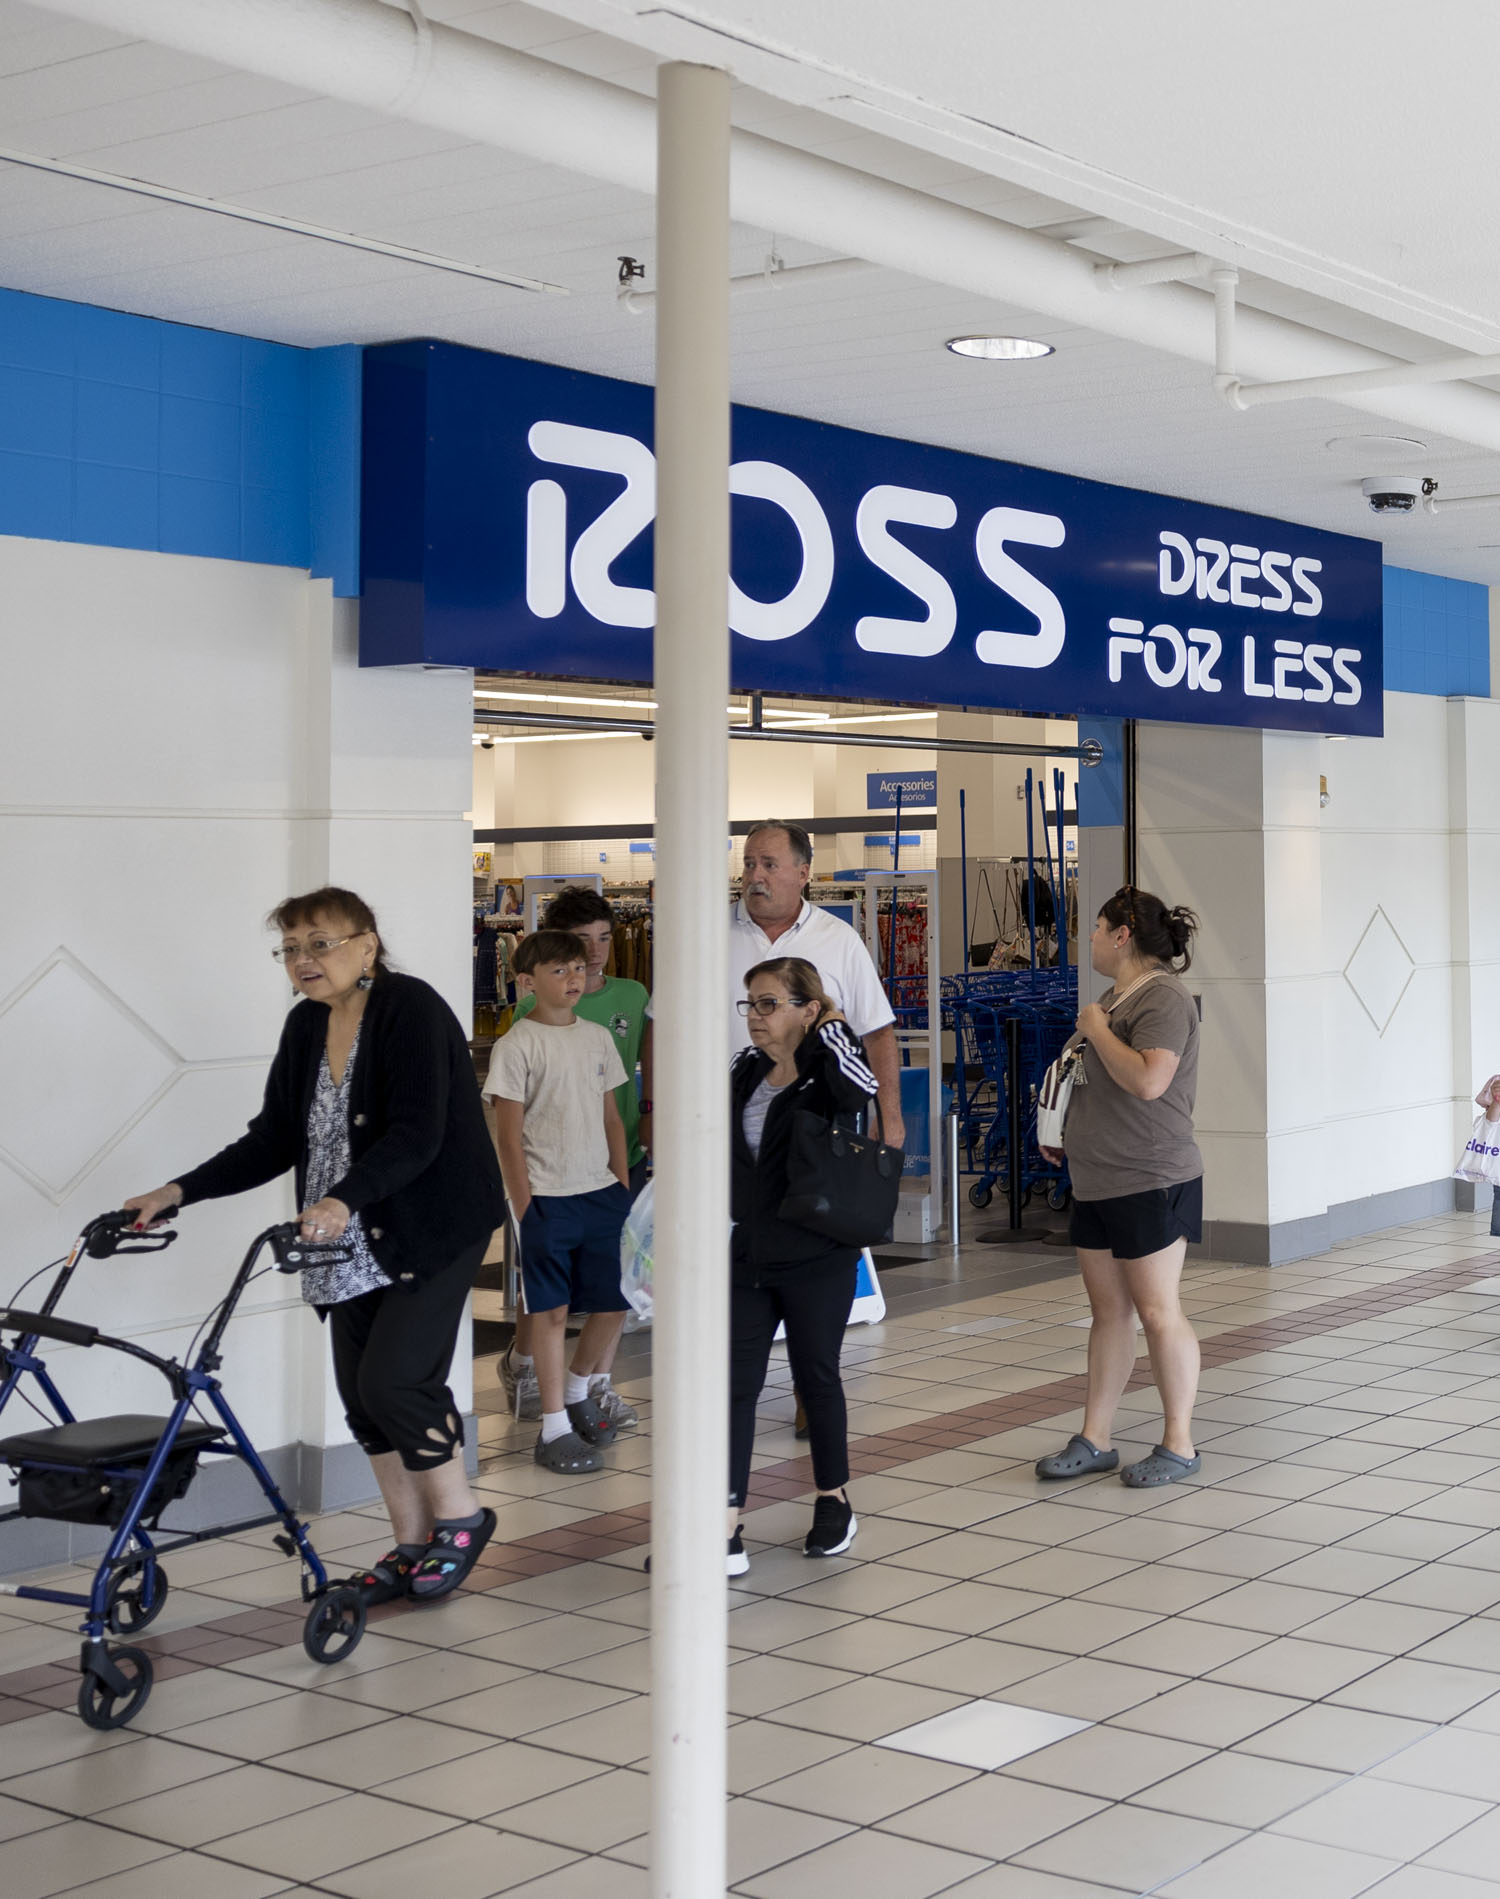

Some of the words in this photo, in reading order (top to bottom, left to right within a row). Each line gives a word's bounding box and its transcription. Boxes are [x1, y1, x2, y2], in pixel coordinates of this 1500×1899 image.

[527, 420, 1066, 668] ROSS
[1159, 530, 1323, 616] DRESS
[1108, 617, 1222, 692] FOR
[1244, 635, 1362, 705] LESS
[880, 778, 935, 792] Accssories
[889, 793, 926, 802] Acesorios
